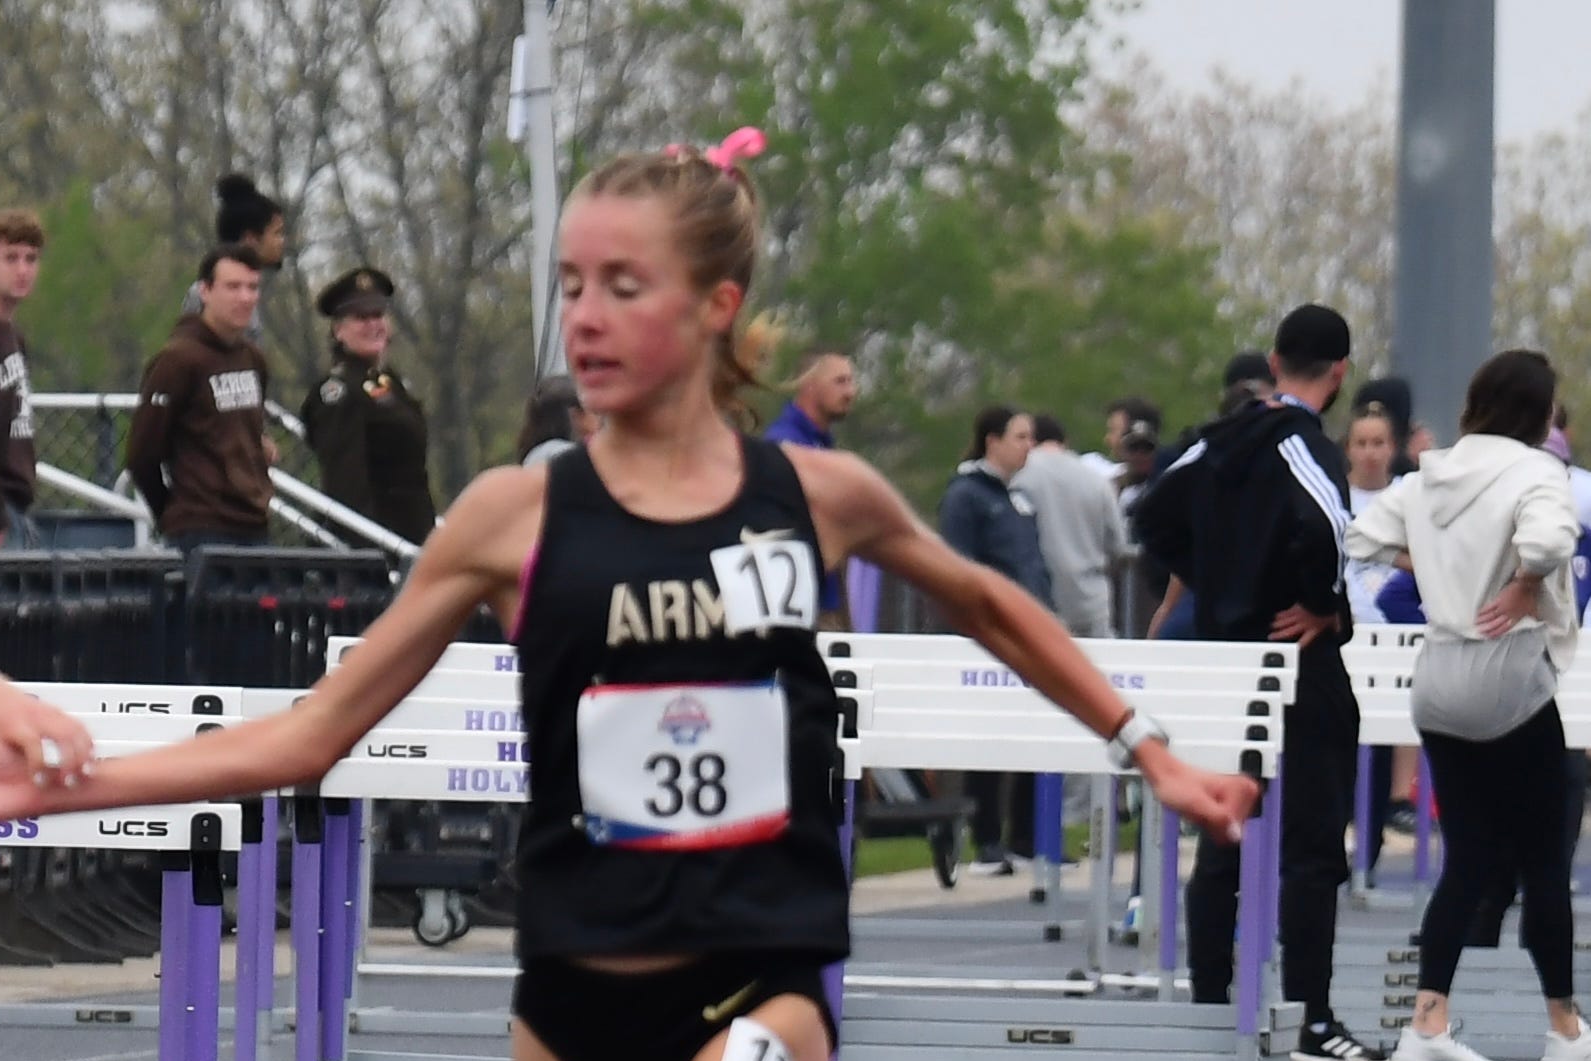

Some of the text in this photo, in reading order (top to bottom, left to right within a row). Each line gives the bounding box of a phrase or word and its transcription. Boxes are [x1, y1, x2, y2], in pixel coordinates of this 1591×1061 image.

[738, 551, 803, 618] 12
[605, 578, 738, 646] ARM
[368, 744, 428, 758] UCS
[643, 752, 727, 818] 38
[98, 819, 169, 837] UCS
[75, 1010, 132, 1023] UCS
[1007, 1029, 1071, 1045] UCS
